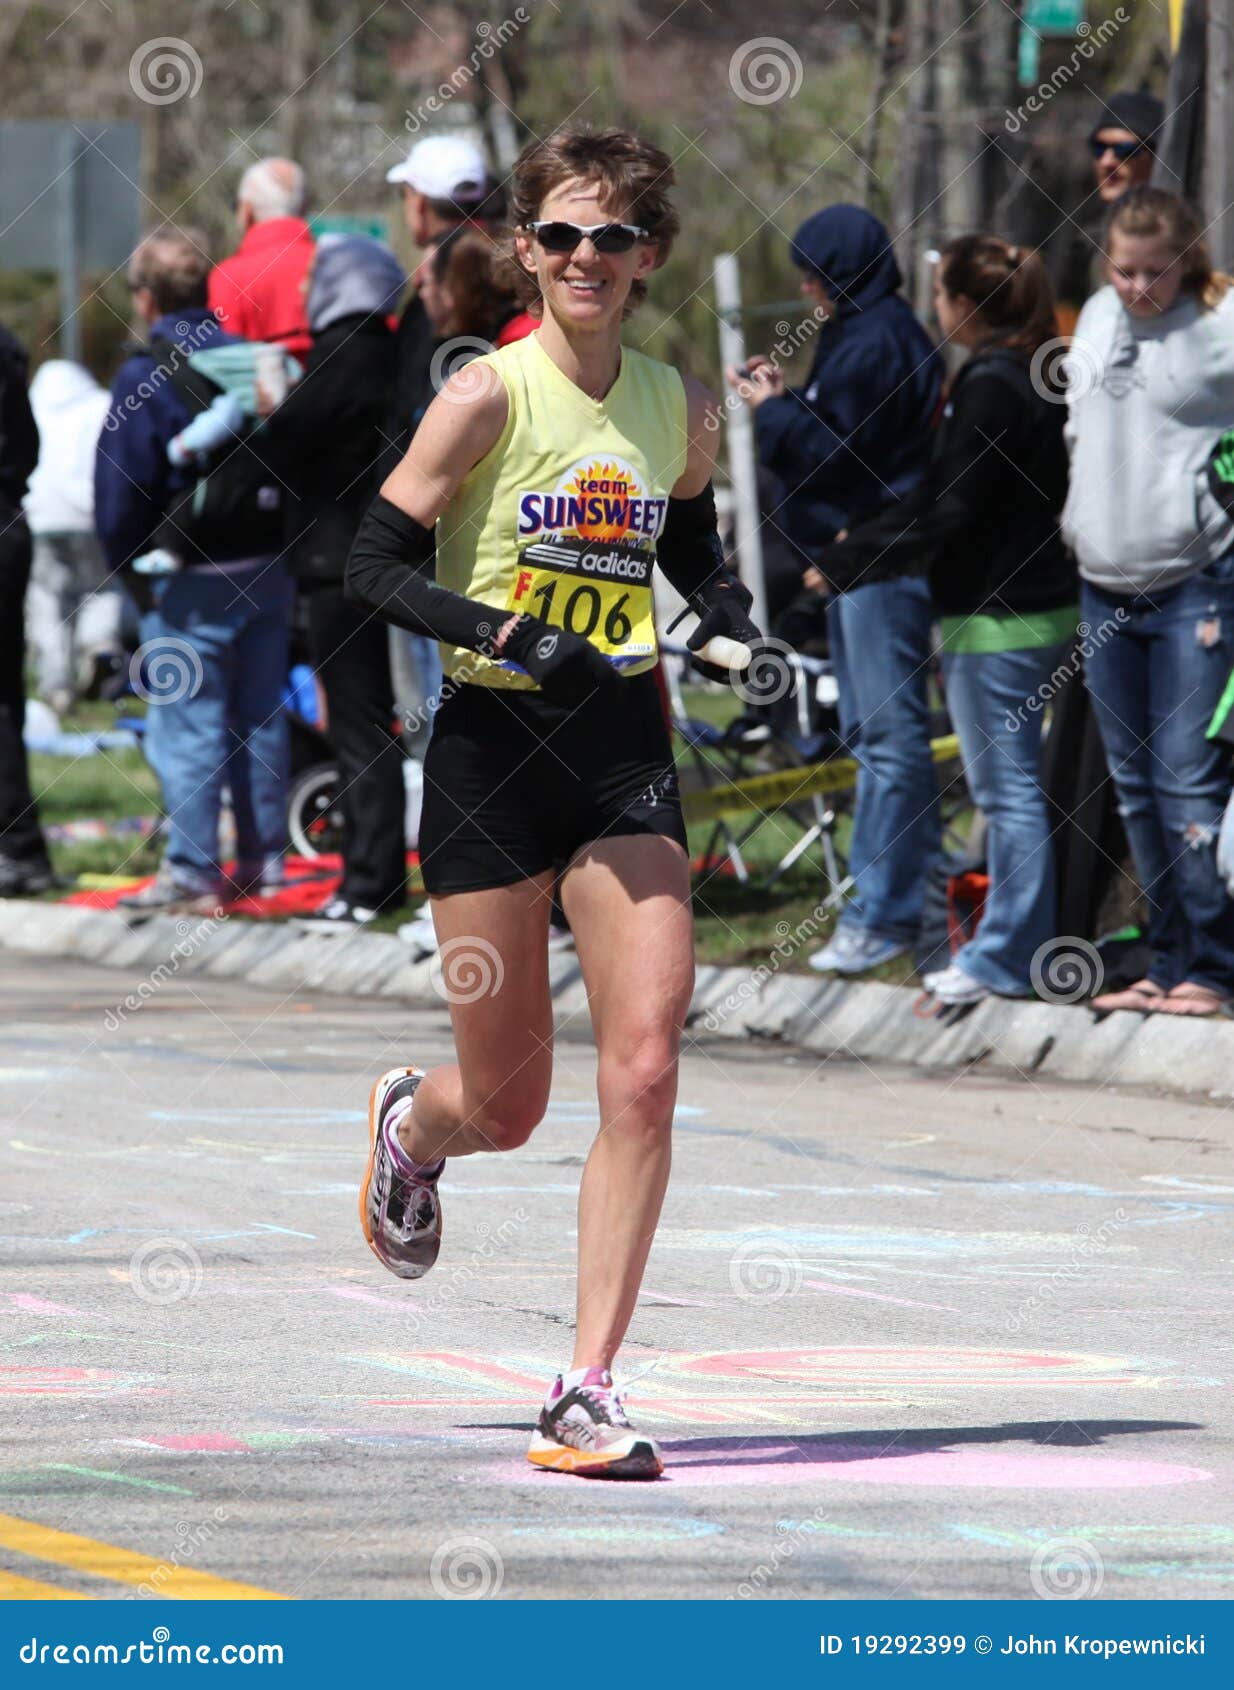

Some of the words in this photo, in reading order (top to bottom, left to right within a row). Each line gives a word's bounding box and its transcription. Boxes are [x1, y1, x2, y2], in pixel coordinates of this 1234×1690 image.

[580, 478, 628, 495] team
[519, 493, 667, 538] SUNSWEET
[581, 552, 648, 579] adidas
[513, 571, 533, 601] F
[534, 579, 633, 645] 106
